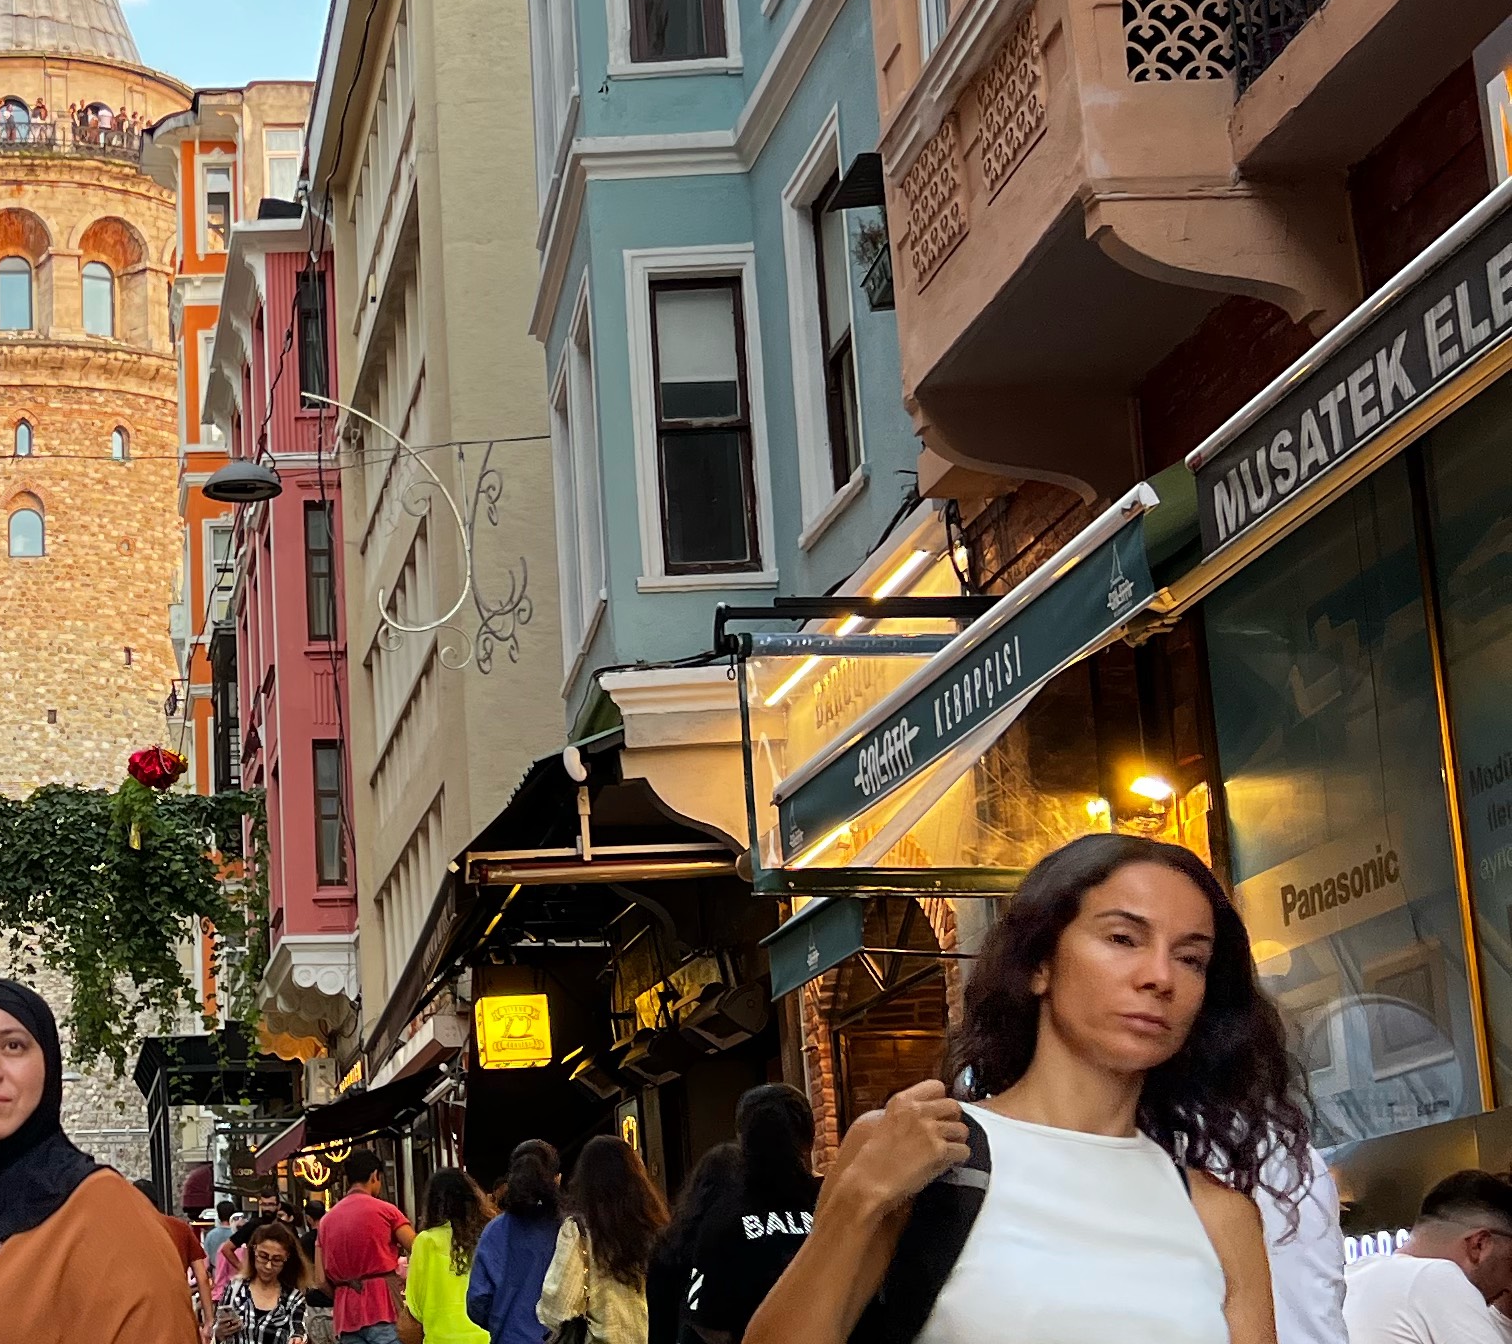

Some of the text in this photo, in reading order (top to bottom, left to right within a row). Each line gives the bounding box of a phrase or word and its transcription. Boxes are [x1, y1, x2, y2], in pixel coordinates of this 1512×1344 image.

[1213, 328, 1417, 542] MUSATEK
[934, 635, 1022, 738] KEBAPÇISI
[1281, 844, 1400, 927] Panasonic
